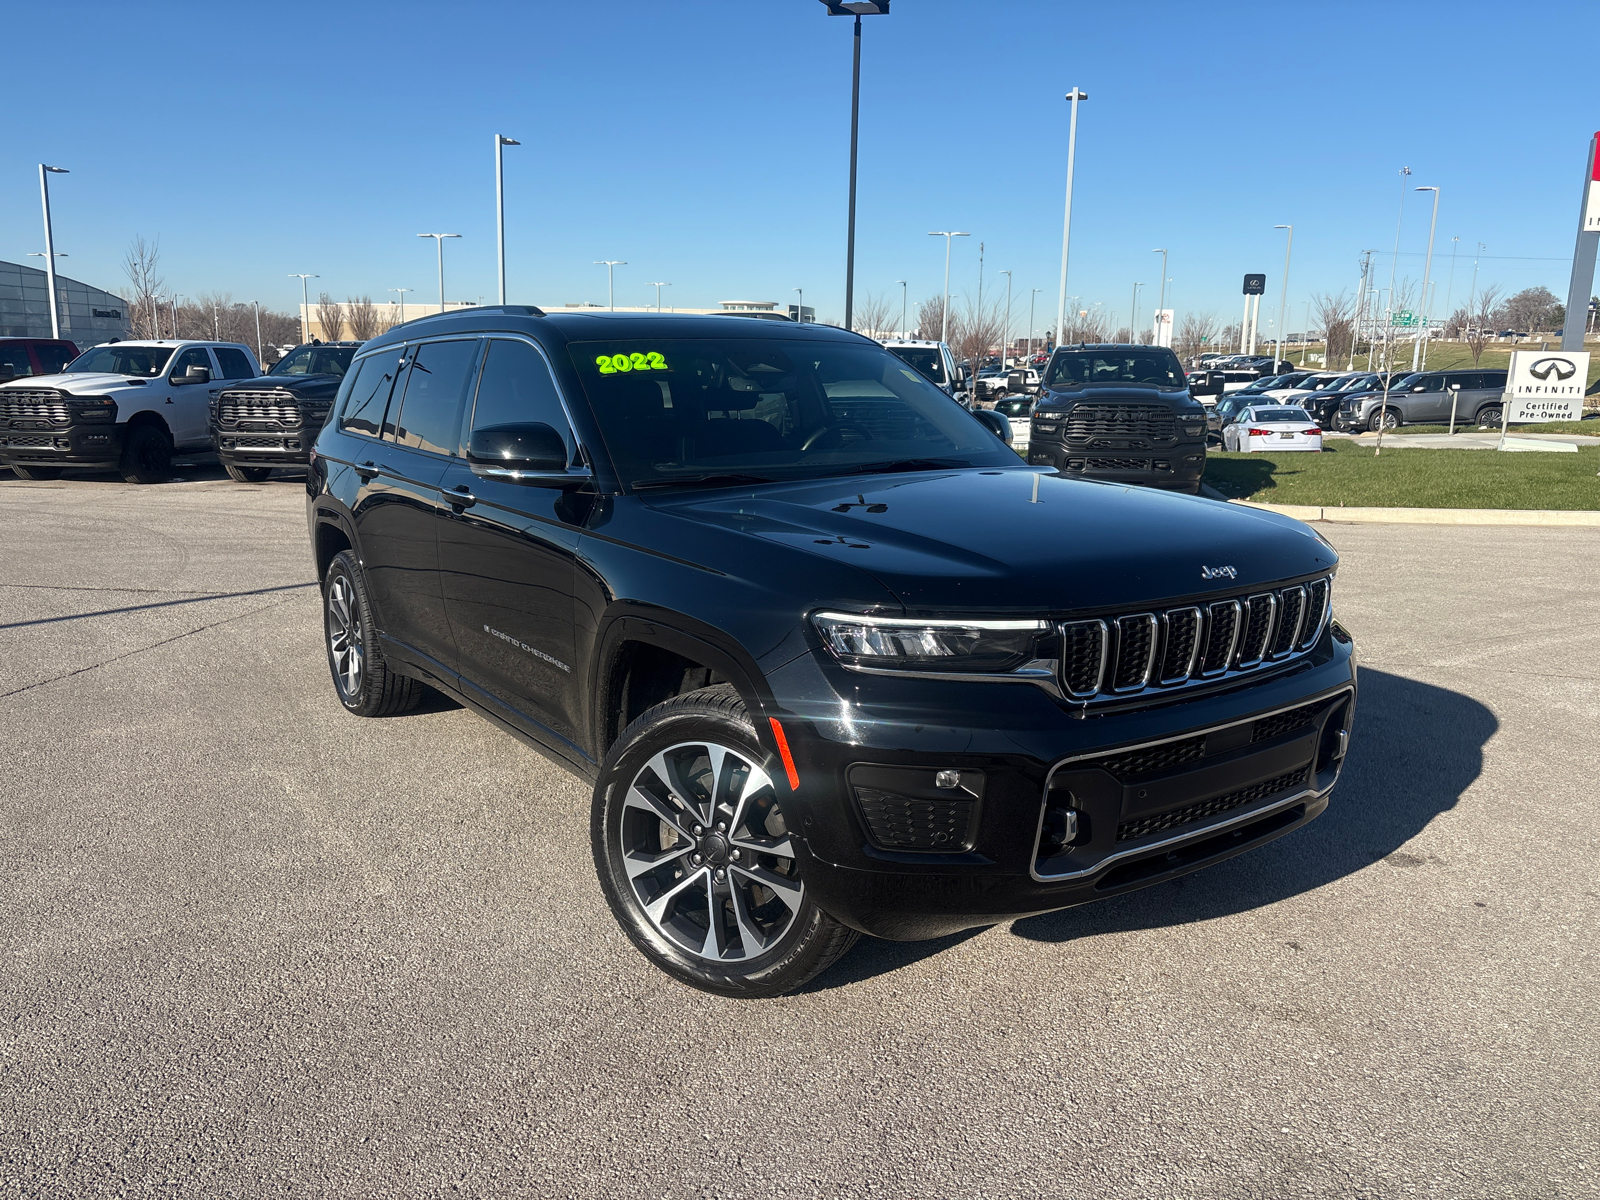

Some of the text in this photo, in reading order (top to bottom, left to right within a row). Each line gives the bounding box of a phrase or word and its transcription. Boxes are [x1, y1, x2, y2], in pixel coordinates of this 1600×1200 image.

[596, 352, 668, 374] 2022
[1519, 386, 1580, 394] INFINITI
[1526, 402, 1569, 410] Certified
[1201, 565, 1237, 579] Jeep
[491, 628, 571, 673] GRAND CHEROKEE
